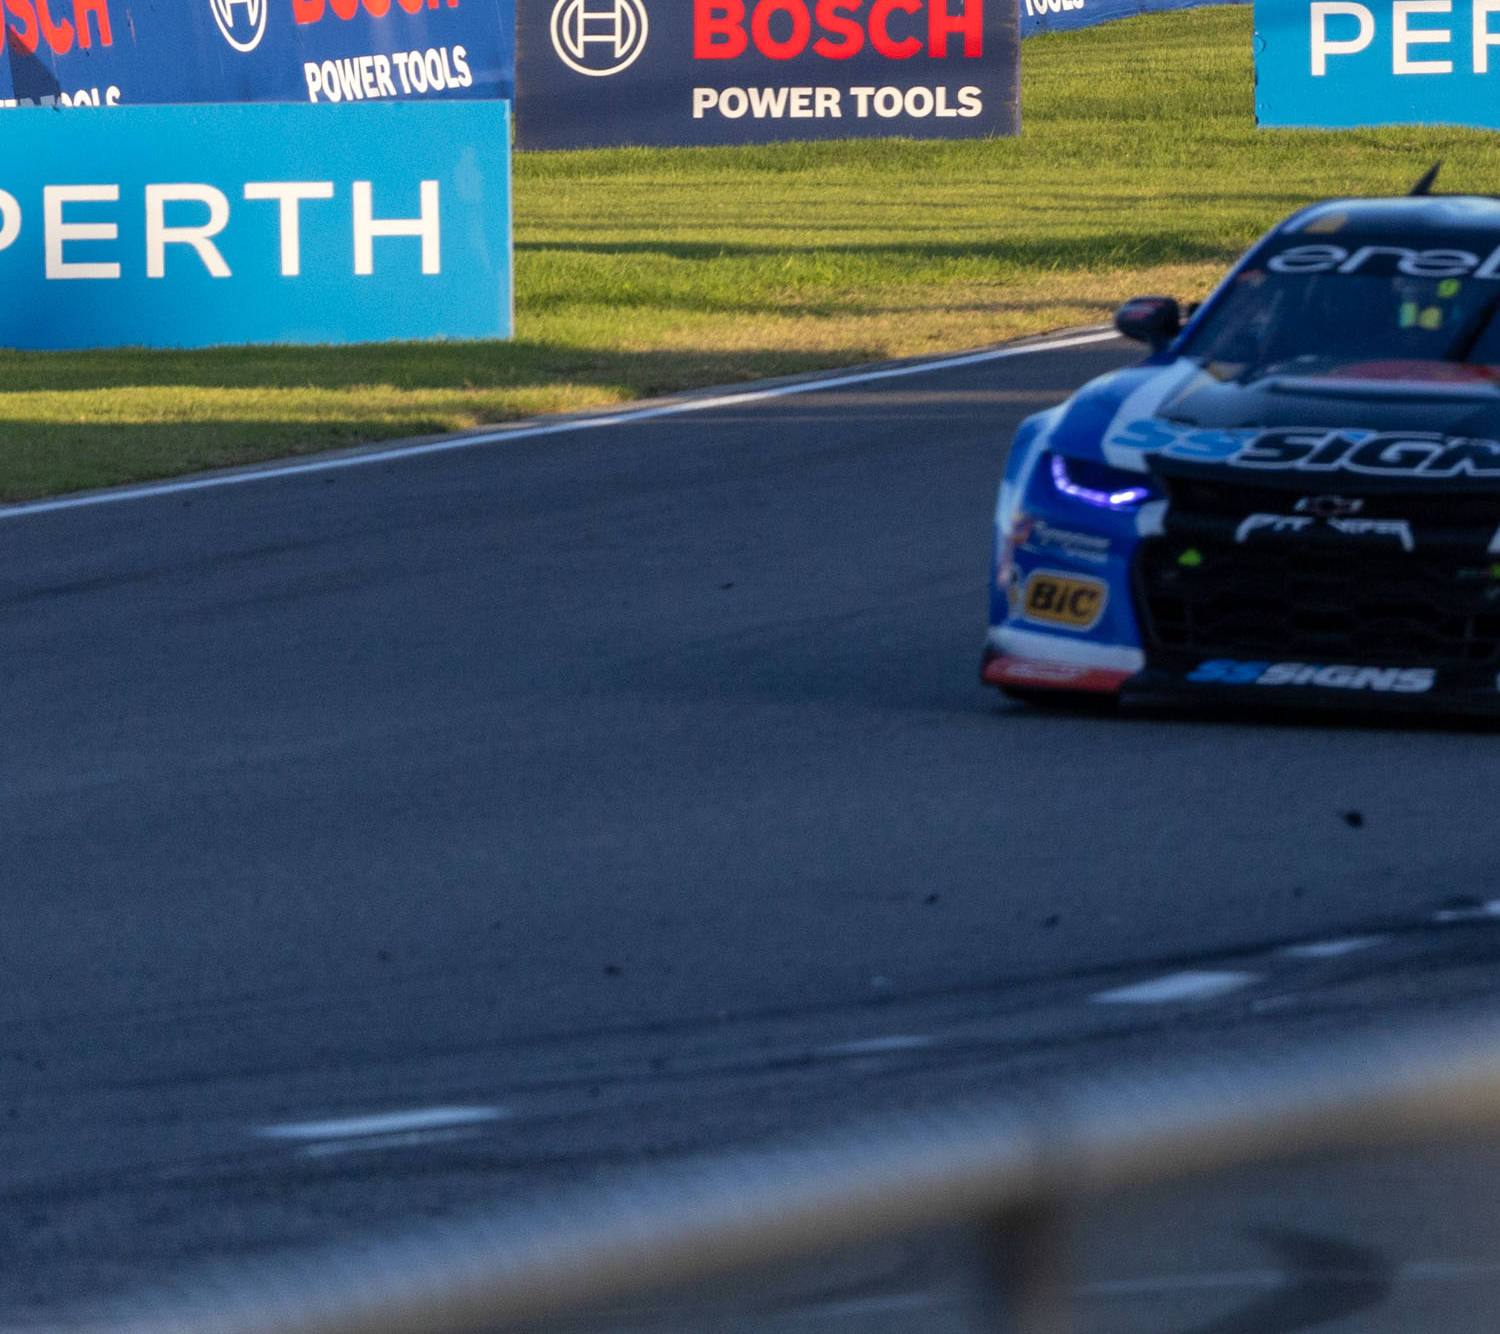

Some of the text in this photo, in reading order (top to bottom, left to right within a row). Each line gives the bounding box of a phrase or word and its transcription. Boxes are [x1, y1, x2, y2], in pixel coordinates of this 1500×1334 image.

[303, 42, 474, 102] POWER TOOLS
[694, 87, 983, 119] POWER TOOLS
